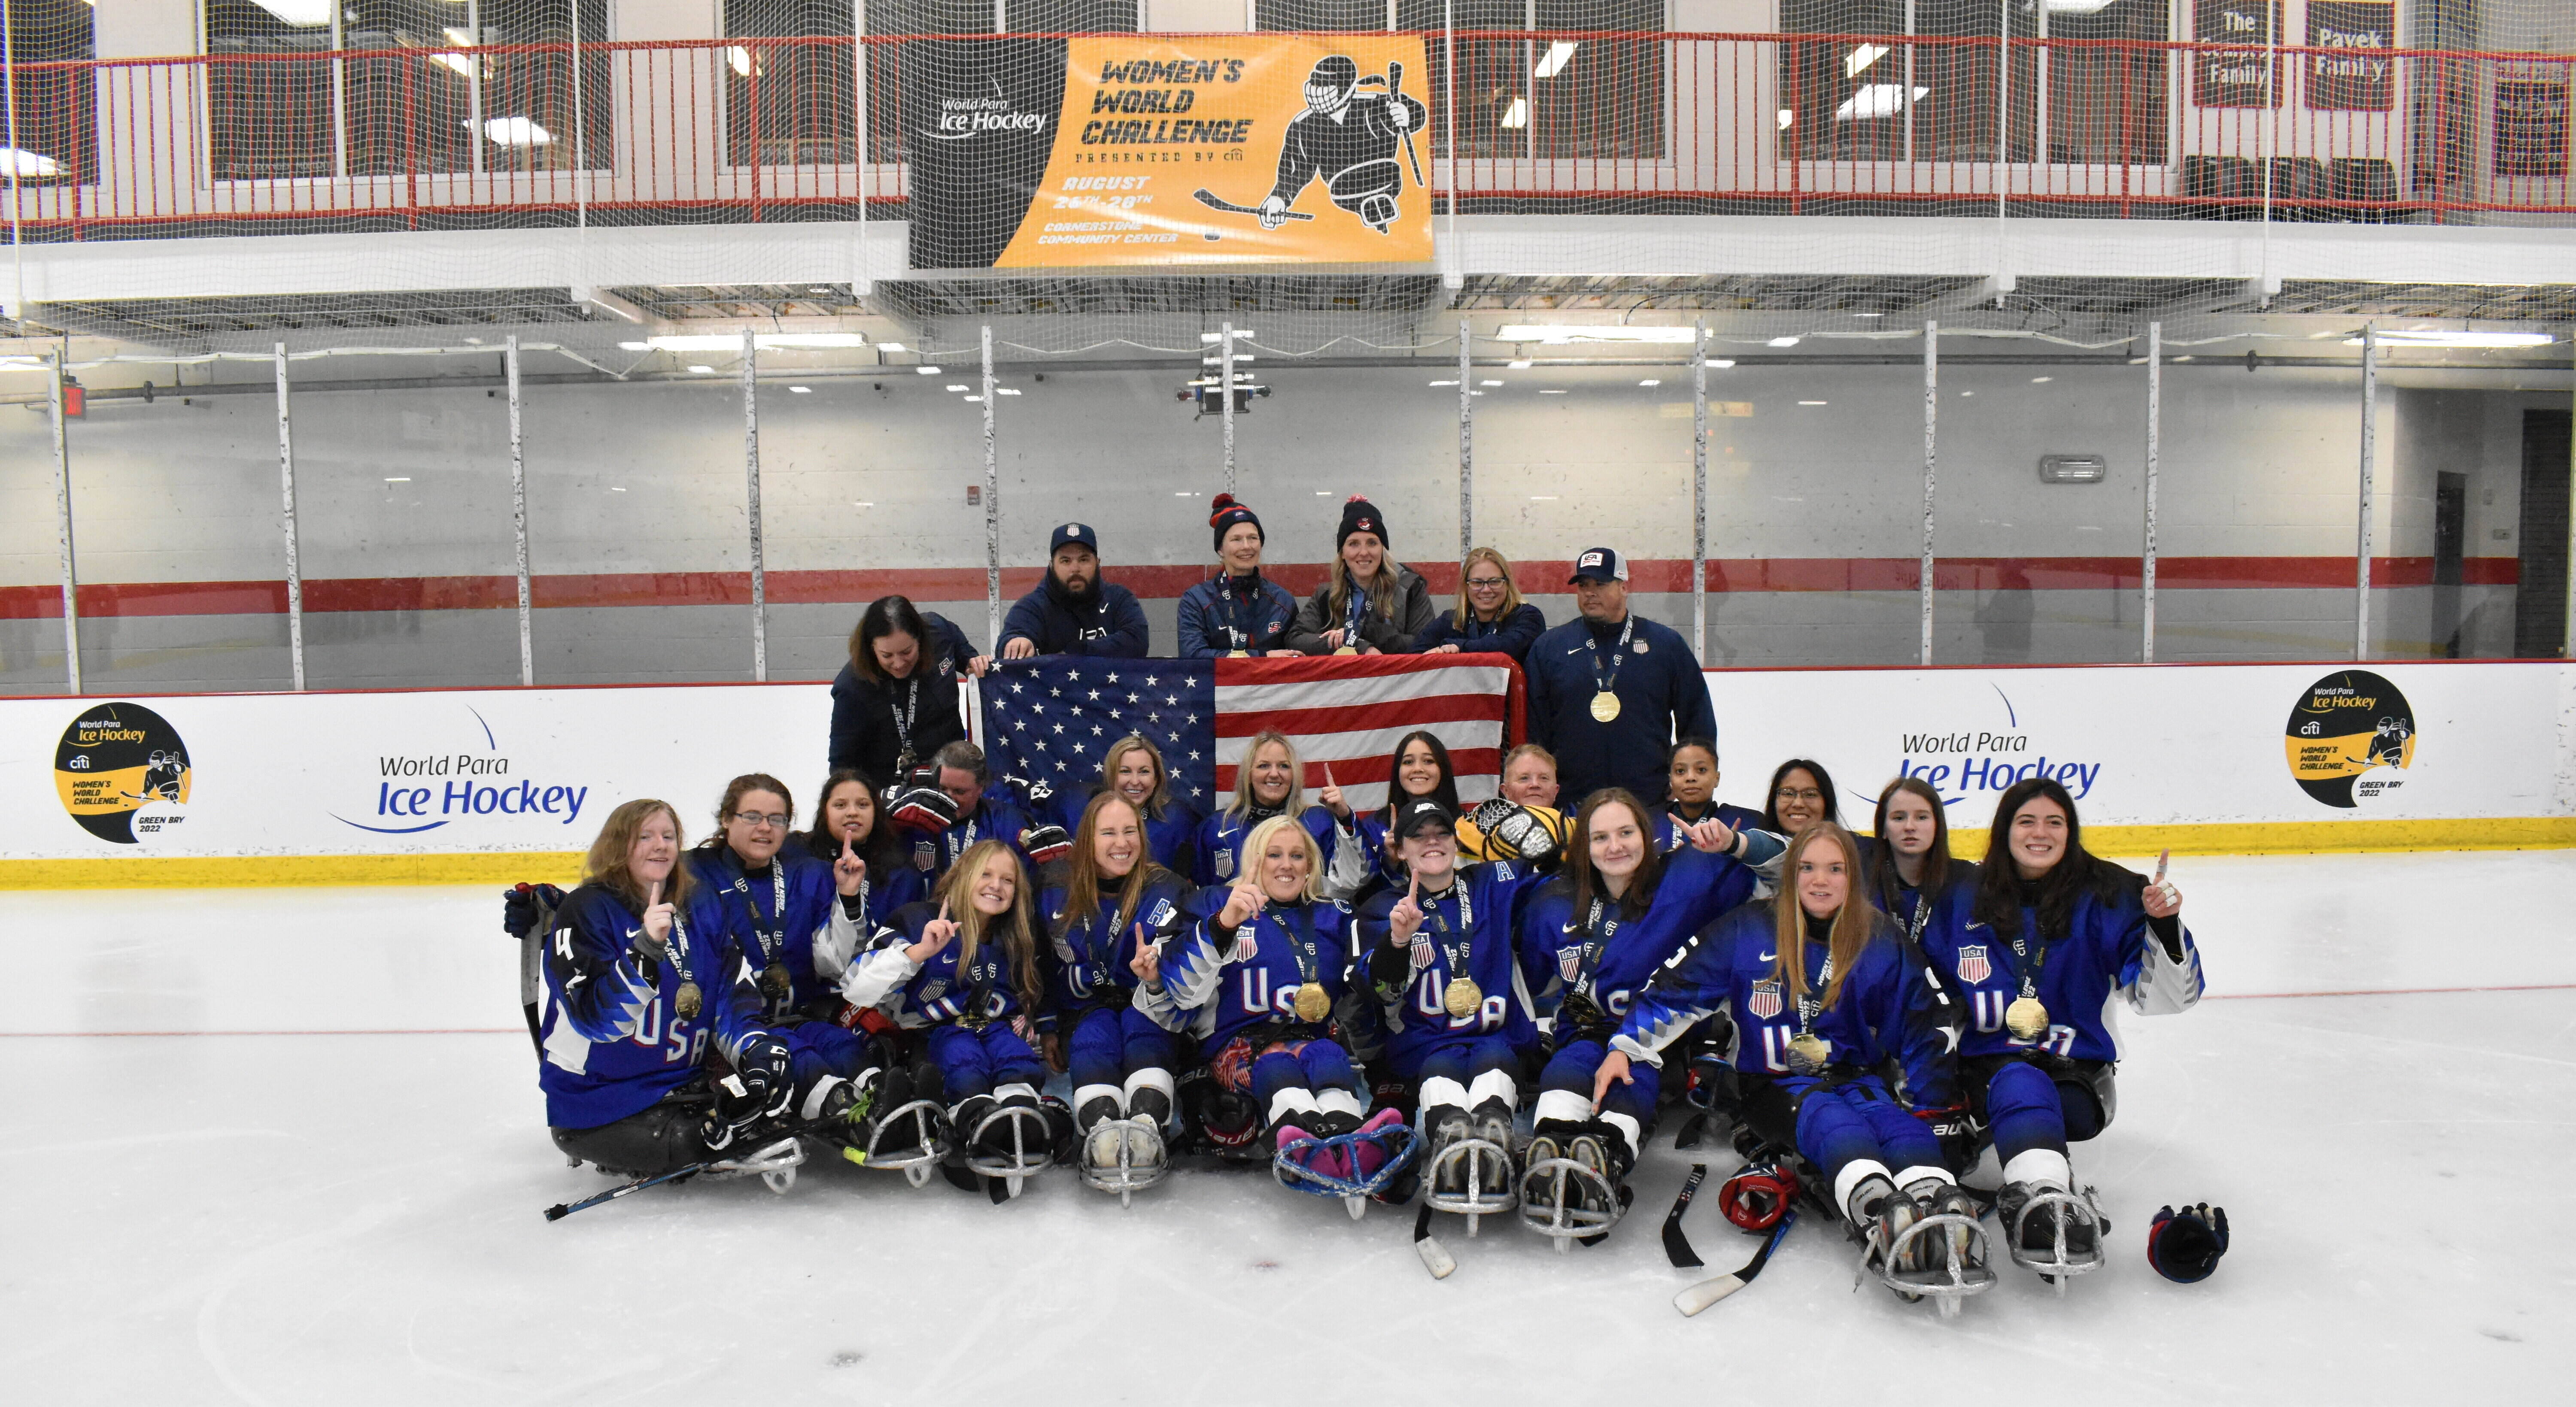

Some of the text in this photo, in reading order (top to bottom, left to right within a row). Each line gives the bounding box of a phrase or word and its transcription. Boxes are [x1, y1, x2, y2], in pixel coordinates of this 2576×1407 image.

[2224, 12, 2255, 31] The
[2320, 28, 2382, 49] Pavek
[1100, 59, 1244, 83] WOMEN'S
[2316, 56, 2385, 82] Famiy
[942, 97, 1008, 110] World Para
[1091, 89, 1195, 114] WORLD
[940, 110, 1048, 135] Ice Hockey
[1081, 119, 1253, 145] CHALLENGE
[1076, 148, 1243, 163] PRESENTED BY citi
[1062, 175, 1151, 191] AUGUST
[1044, 221, 1142, 232] CORNERSTONE
[1037, 232, 1179, 244] COMMUNITY CENTER
[1614, 654, 1622, 666] citi
[2313, 696, 2376, 710] Ice Hockey
[79, 729, 146, 744] Ice Hockey
[2301, 722, 2321, 735] citi
[1903, 732, 2027, 753] World Para
[70, 755, 90, 769] citi
[380, 755, 509, 776] World Para
[73, 797, 120, 805] CHALLENGE
[378, 779, 588, 825] Ice Hockey
[1495, 861, 1515, 882] A
[735, 877, 748, 892] citi
[1460, 879, 1468, 894] 2022
[1423, 898, 1436, 909] citi
[1462, 894, 1470, 904] BAY
[1112, 919, 1122, 936] 2022
[1272, 914, 1286, 926] citi
[1605, 920, 1618, 936] citi
[773, 931, 783, 946] citi
[1304, 942, 1316, 955] citi
[1460, 942, 1470, 958] citi
[1561, 950, 1578, 959] USA
[2013, 939, 2026, 956] citi
[972, 966, 982, 981] citi
[988, 962, 996, 979] citi
[1092, 970, 1104, 986] citi
[1817, 958, 1831, 986] WOMEN'S
[1579, 980, 1589, 995] 022
[2021, 975, 2032, 997] LLENGE
[1419, 968, 1507, 1031] UA
[1810, 1000, 1821, 1017] citi
[1975, 989, 2077, 1056] UA
